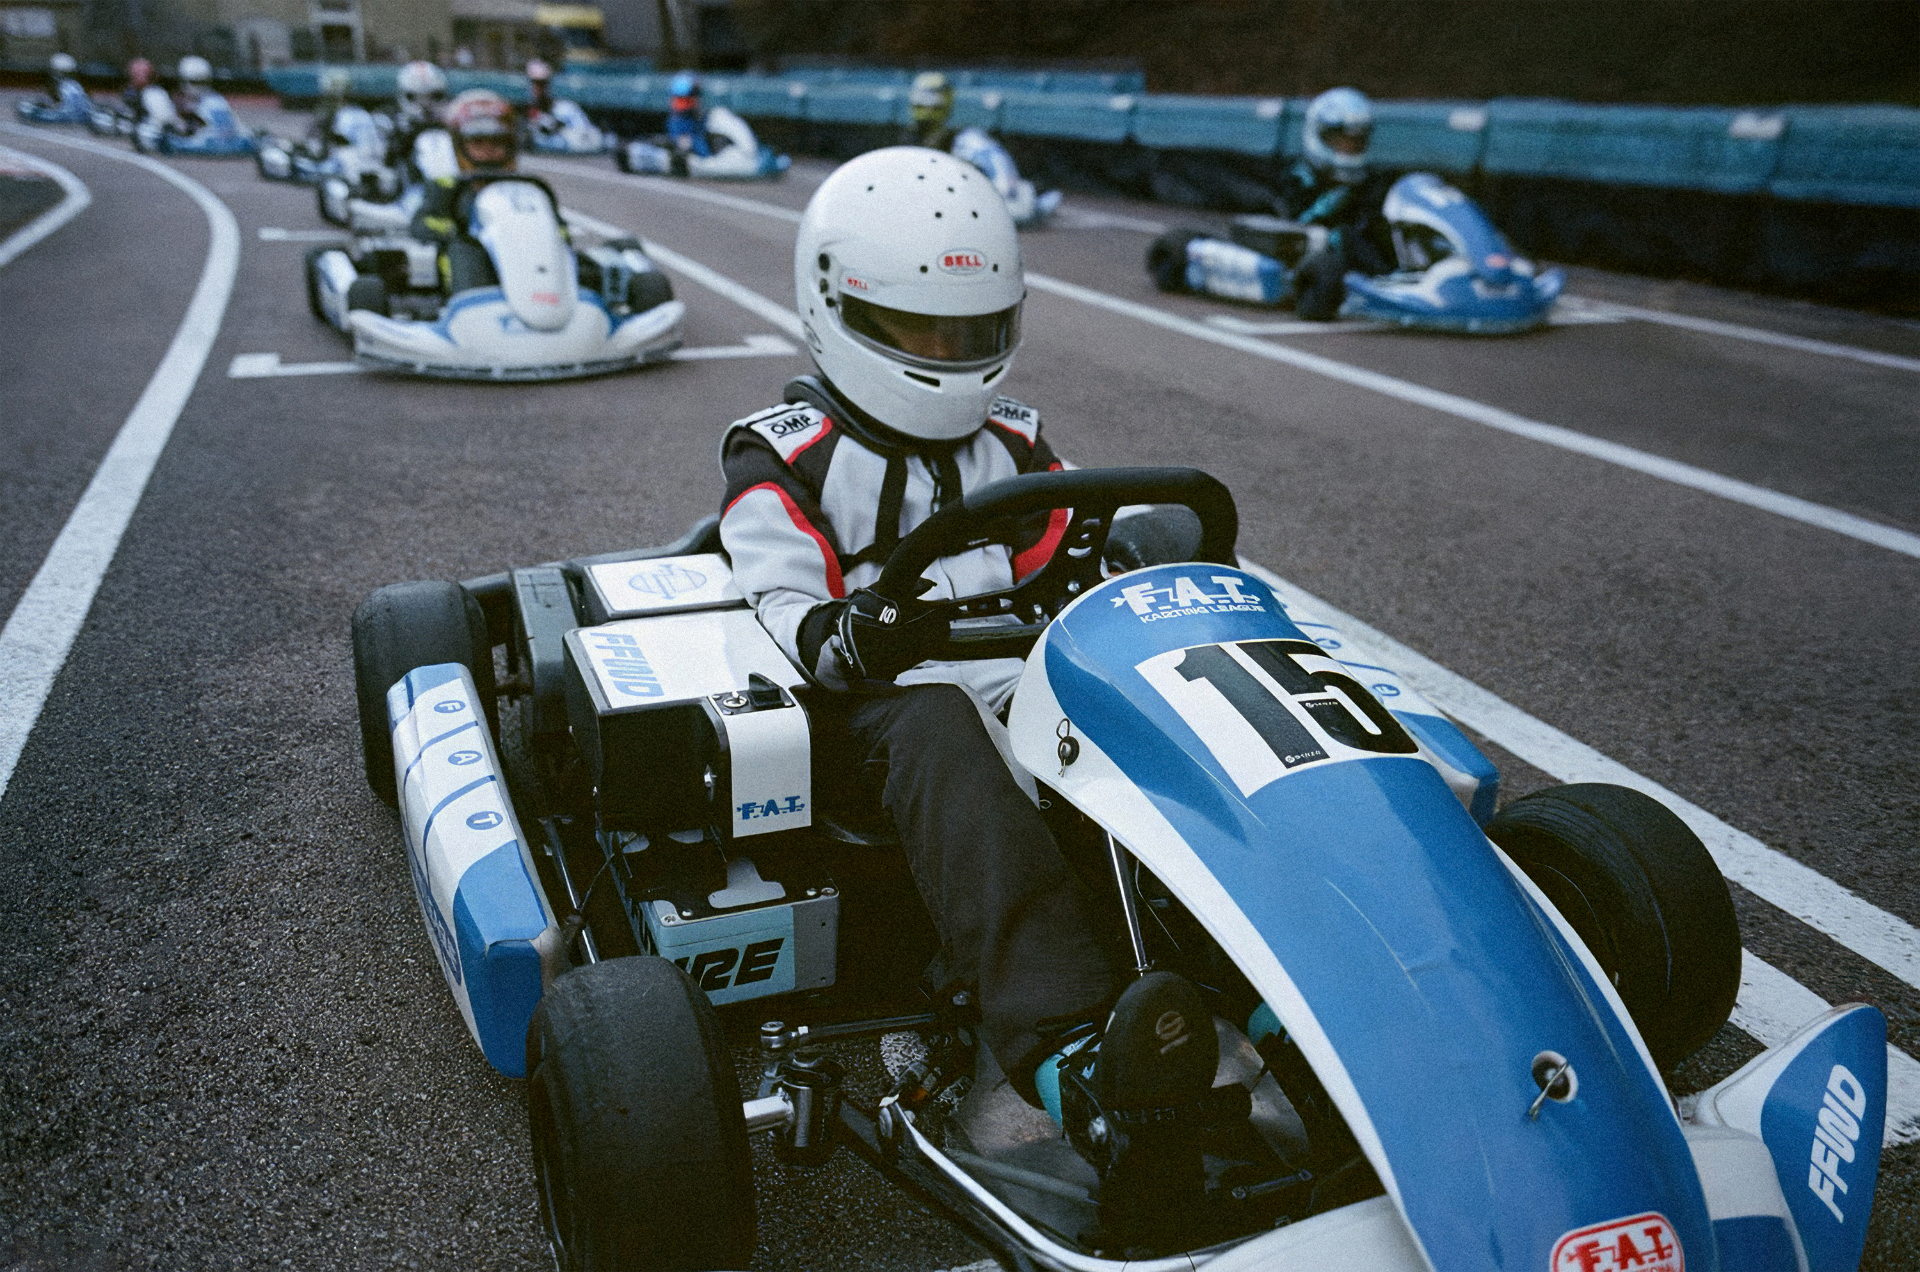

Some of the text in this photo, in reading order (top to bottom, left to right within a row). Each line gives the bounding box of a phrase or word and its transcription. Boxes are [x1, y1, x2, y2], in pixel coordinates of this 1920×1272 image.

[944, 254, 983, 267] BELL
[771, 414, 811, 435] OMP
[1140, 604, 1267, 624] KARTING LEAGUE
[589, 632, 665, 697] FFWD
[1174, 640, 1420, 769] 15
[1808, 1064, 1866, 1224] FFWD
